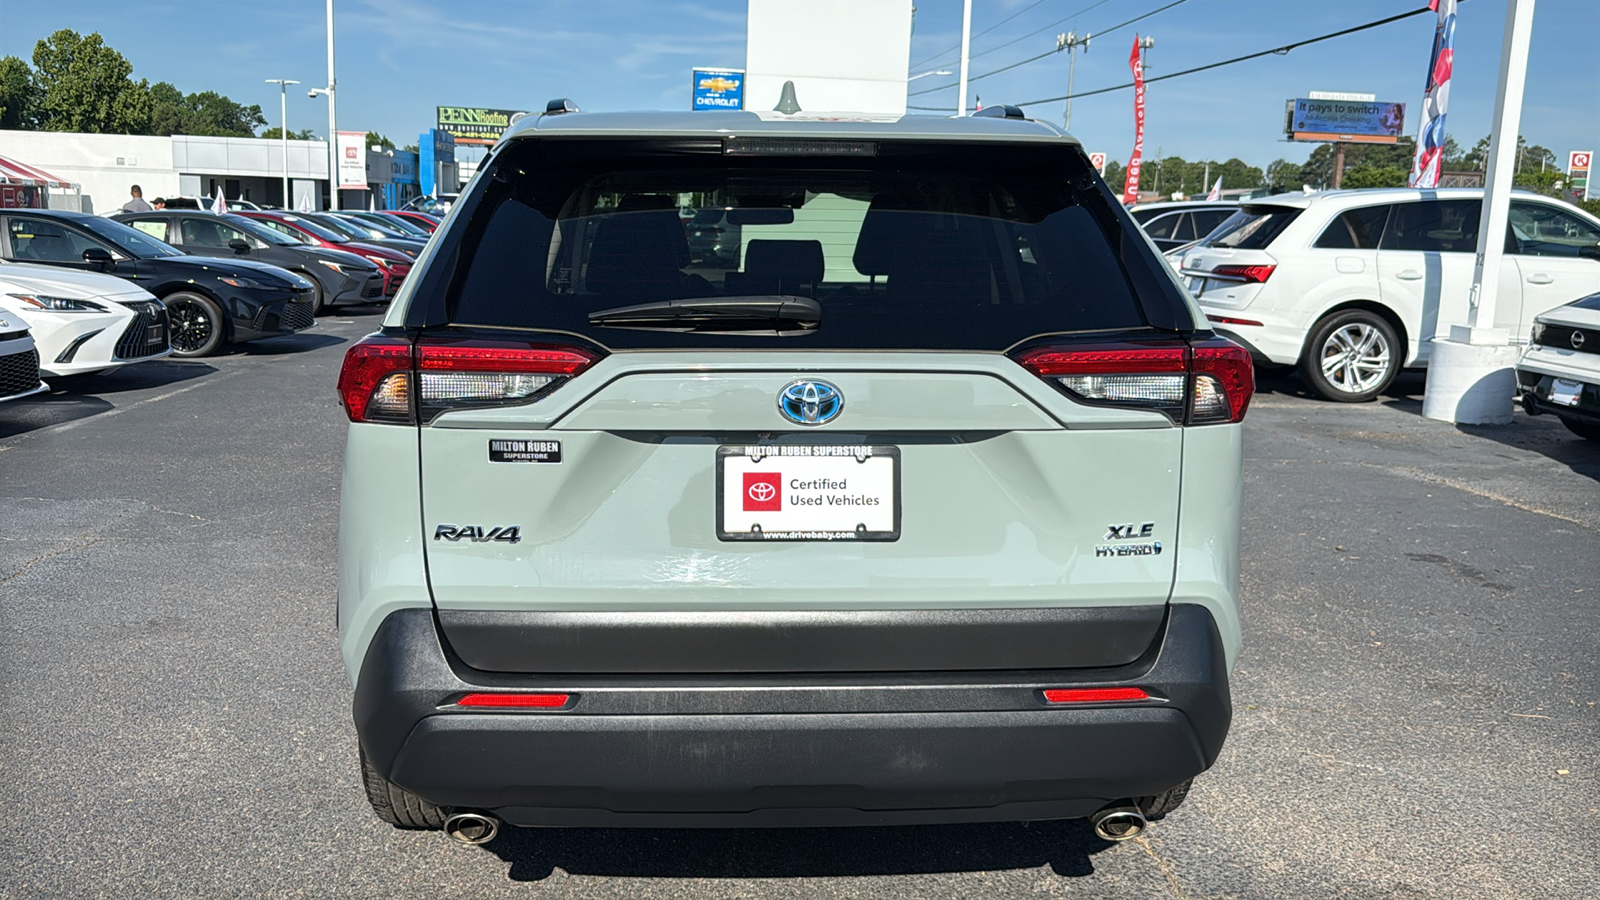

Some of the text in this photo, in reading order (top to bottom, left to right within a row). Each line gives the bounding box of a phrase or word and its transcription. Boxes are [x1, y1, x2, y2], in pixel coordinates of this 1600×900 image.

[696, 97, 739, 107] CHEVROLET
[1300, 102, 1379, 114] It pays to switch
[480, 112, 508, 126] Roofing
[491, 440, 559, 452] MILTON RUBEN
[744, 445, 873, 456] MILTON RUBEN SUPERSTORE
[790, 478, 847, 490] Certified
[790, 494, 880, 506] Used Vehicles
[434, 524, 521, 544] RAV4
[763, 531, 855, 540] www.drivebaby.com
[1103, 521, 1154, 540] XLE
[1095, 543, 1152, 557] HYBRID
